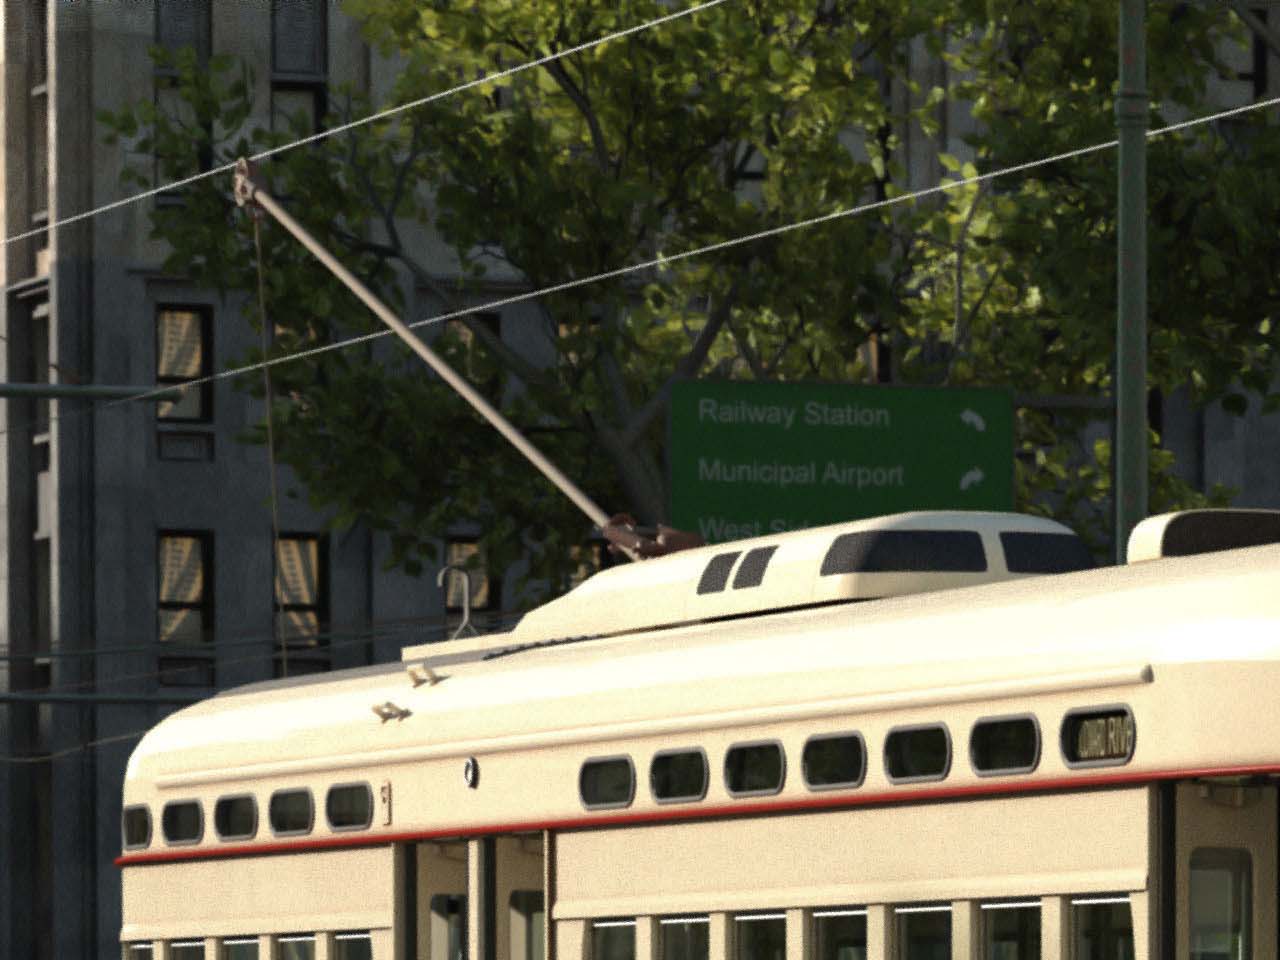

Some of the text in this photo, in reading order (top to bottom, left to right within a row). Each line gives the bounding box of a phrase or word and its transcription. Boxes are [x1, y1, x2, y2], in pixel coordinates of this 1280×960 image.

[698, 398, 890, 430] Railway Station
[698, 457, 904, 490] Municipal Airport
